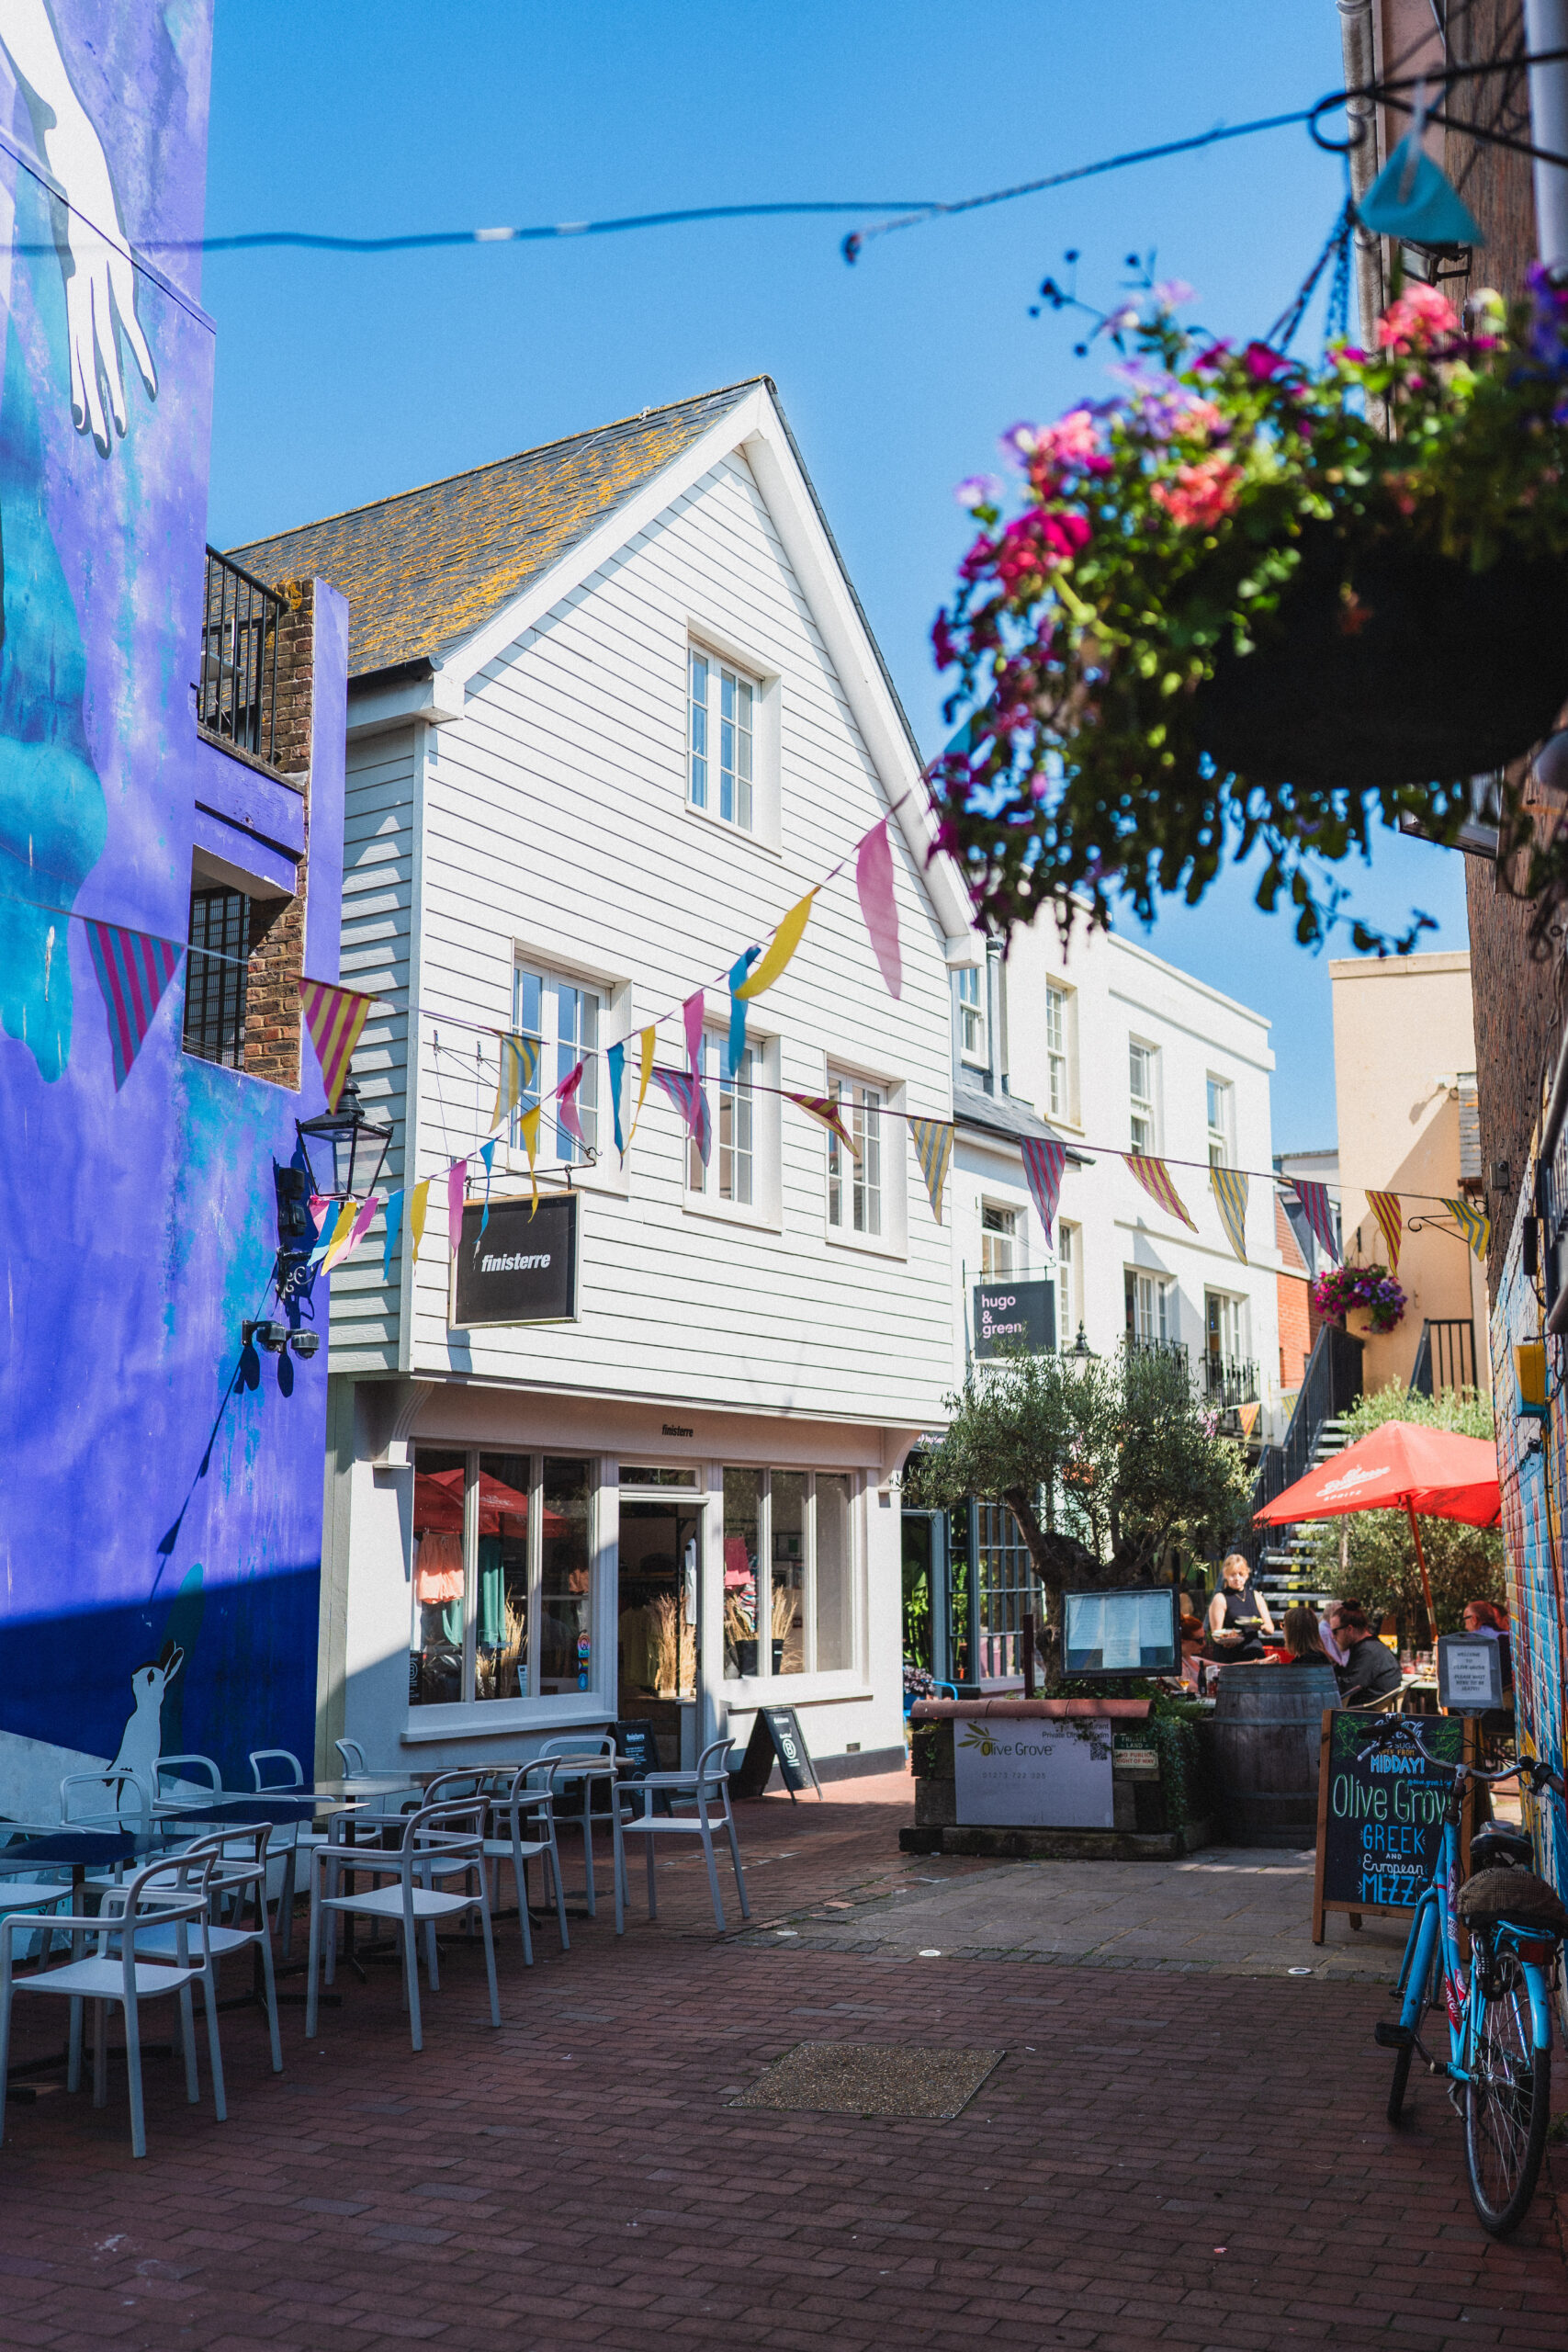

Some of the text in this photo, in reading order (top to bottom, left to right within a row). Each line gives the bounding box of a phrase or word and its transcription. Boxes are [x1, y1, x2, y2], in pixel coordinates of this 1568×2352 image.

[481, 1252, 551, 1272] finisterre
[981, 1294, 1017, 1311] hugo
[982, 1310, 993, 1324] &
[982, 1323, 1022, 1339] green
[661, 1424, 694, 1438] finisterre
[982, 1741, 1053, 1757] Olive Grove
[1371, 1754, 1425, 1774] MIDDAY!
[1333, 1773, 1388, 1821] Olive
[1362, 1824, 1425, 1855] GREEK
[1362, 1853, 1425, 1880] European
[1362, 1873, 1428, 1906] MEZZ
